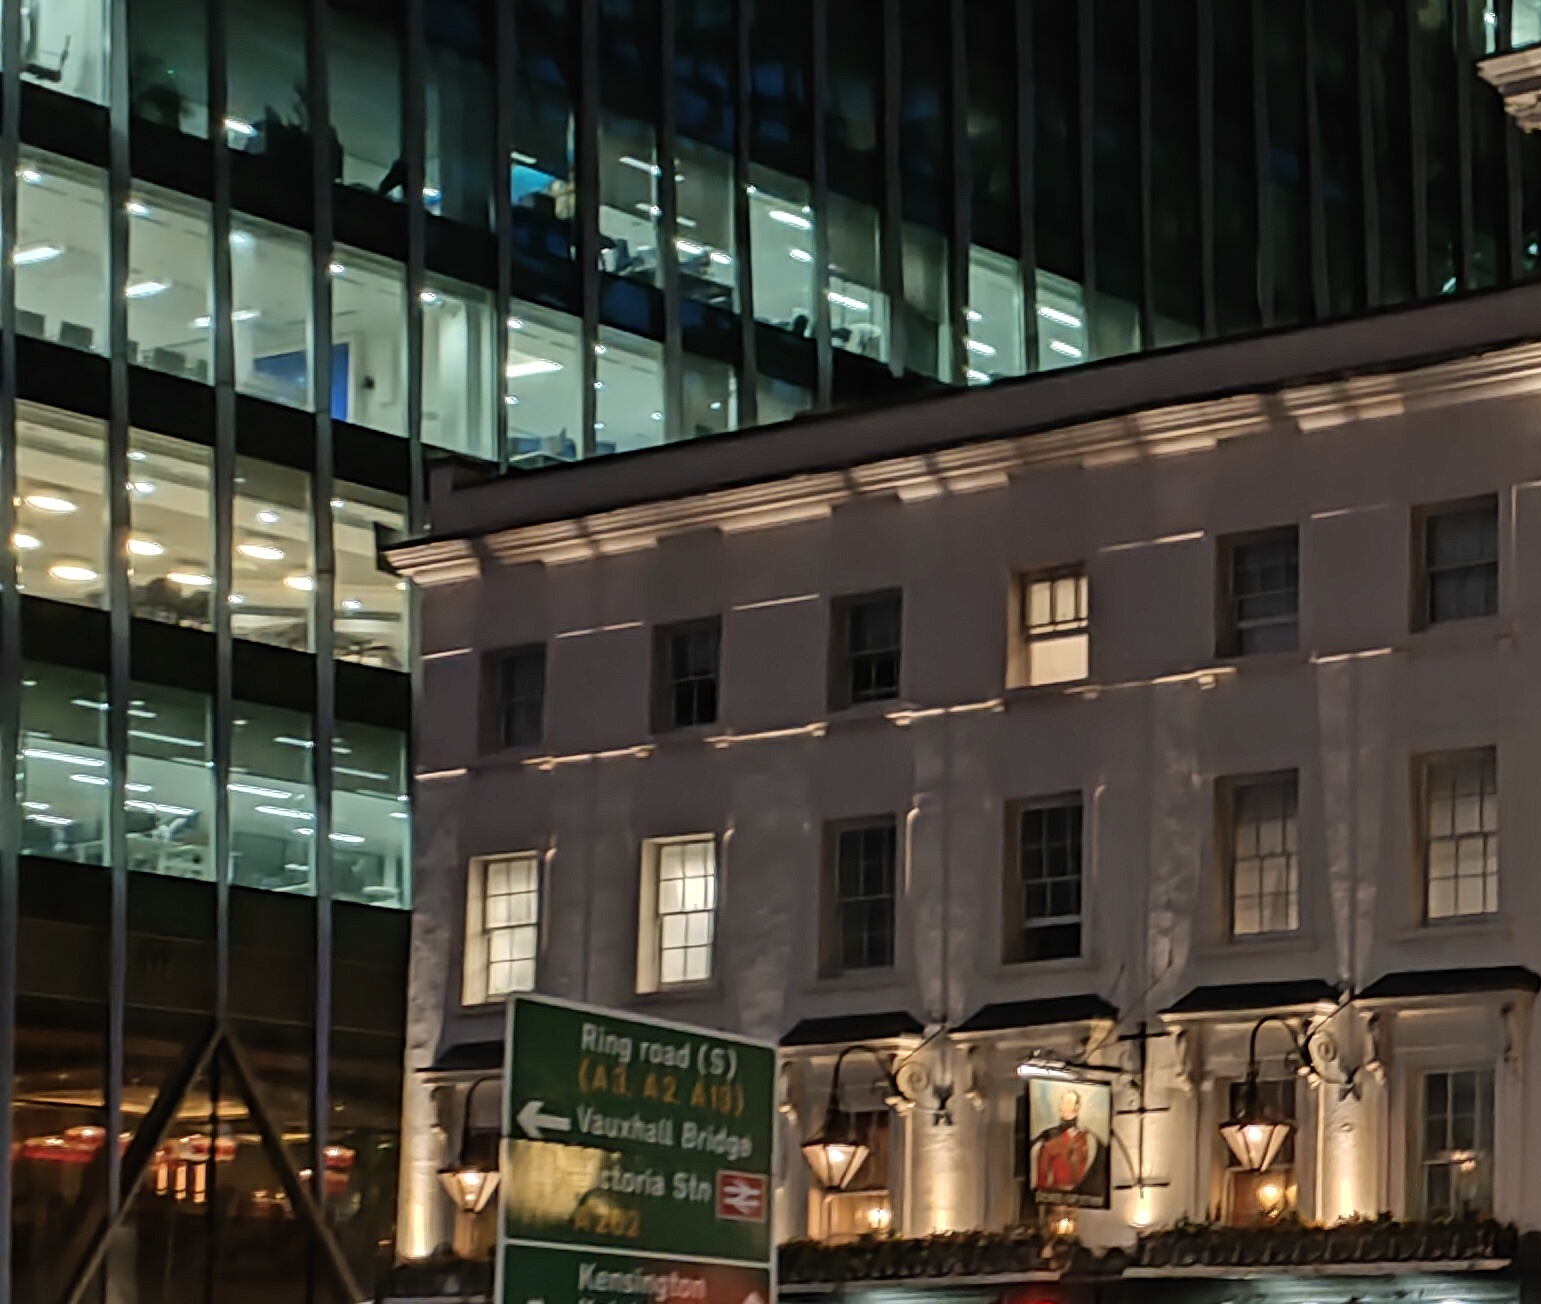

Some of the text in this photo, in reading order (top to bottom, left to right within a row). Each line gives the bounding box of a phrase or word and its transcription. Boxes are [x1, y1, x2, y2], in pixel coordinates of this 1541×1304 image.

[581, 1022, 738, 1081] Ring road (S)
[576, 1103, 752, 1161] Vauxhall Bridge
[598, 1165, 712, 1203] ctoria Stn
[578, 1262, 707, 1302] Kensington
